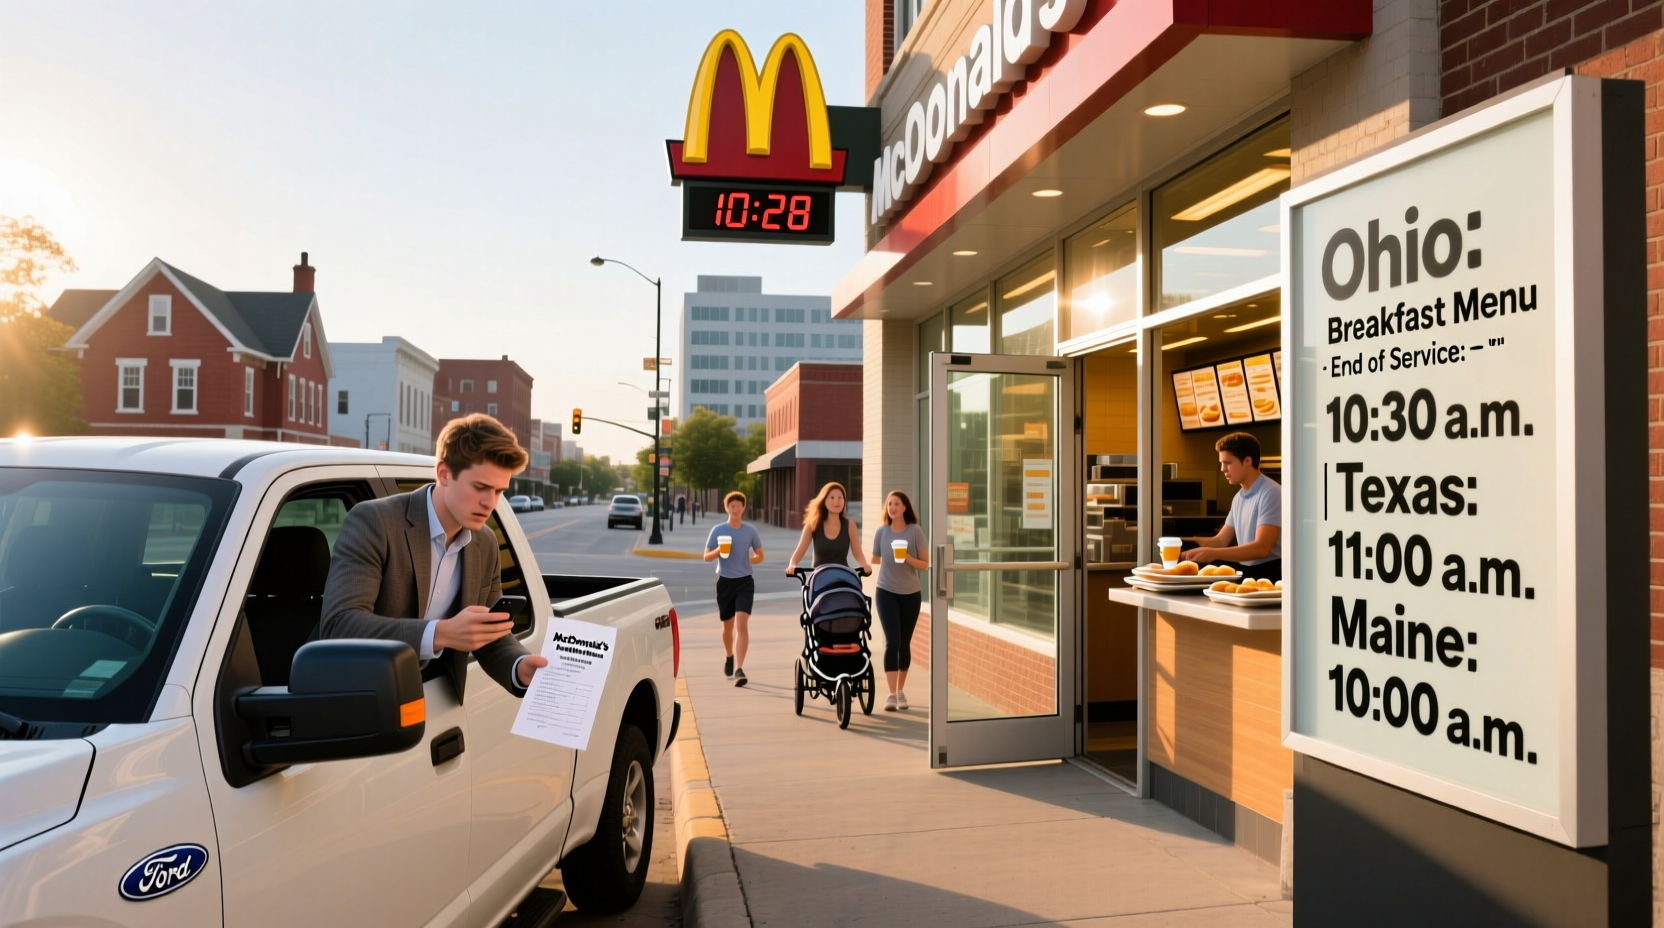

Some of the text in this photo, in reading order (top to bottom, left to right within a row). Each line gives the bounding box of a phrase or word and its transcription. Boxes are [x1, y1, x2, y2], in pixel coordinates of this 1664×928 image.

[871, 0, 1067, 225] McDonald
[715, 192, 812, 231] 10:28
[1321, 205, 1482, 301] Ohio:
[1328, 284, 1537, 345] Breakfast Menu
[1331, 352, 1363, 378] End
[1367, 348, 1387, 373] of
[1389, 341, 1466, 371] Service:
[1325, 387, 1534, 444] 10:30 a.m.
[1336, 461, 1478, 517] Texas:
[1328, 530, 1535, 600] 11:00 a.m.
[1331, 595, 1478, 673] Maine:
[1328, 664, 1538, 765] 10:00 a.m.
[138, 853, 192, 893] Ford
